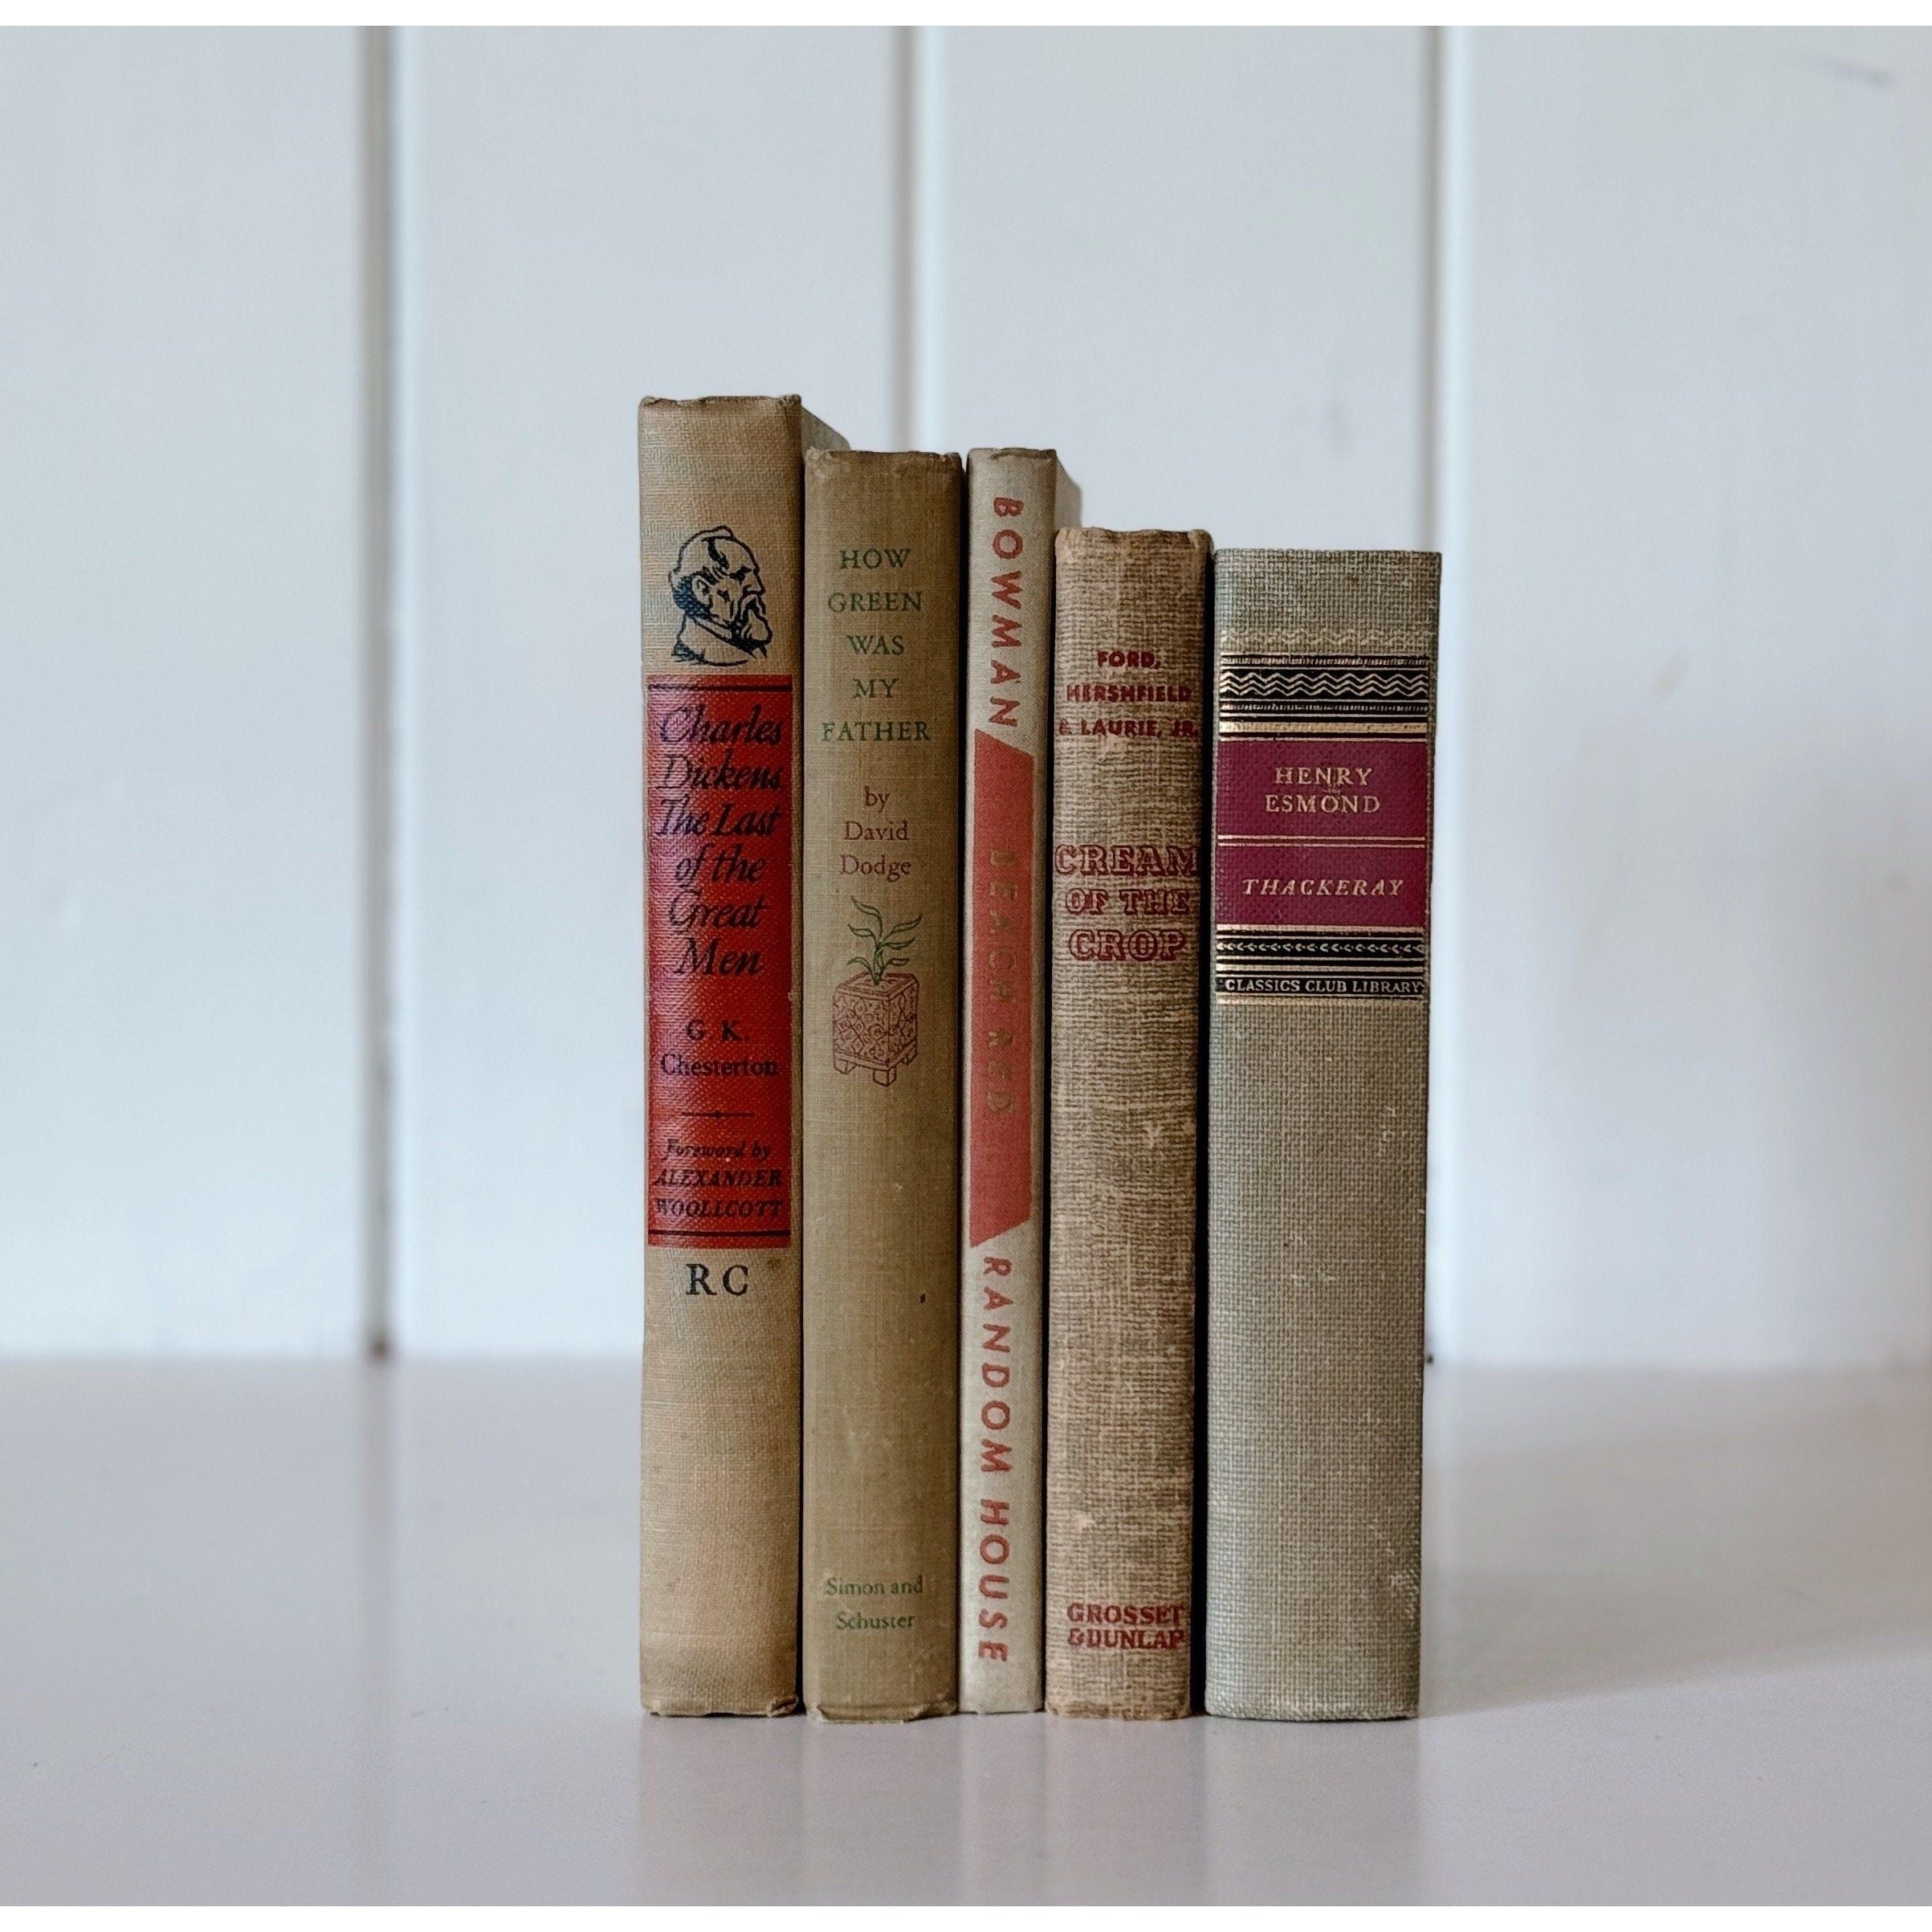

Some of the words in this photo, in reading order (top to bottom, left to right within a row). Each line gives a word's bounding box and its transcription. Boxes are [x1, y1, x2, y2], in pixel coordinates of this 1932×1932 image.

[840, 548, 911, 569] HOW
[828, 591, 922, 613] GREEN
[988, 496, 1024, 727] BOWMAN
[847, 635, 905, 655] WAS
[1097, 650, 1161, 670] FORD,
[852, 679, 899, 698] MY
[1066, 684, 1192, 703] HERSHFIELD
[658, 703, 783, 745] Charles
[821, 722, 930, 741] FATHER
[1058, 720, 1072, 736] &
[1081, 719, 1162, 737] LAURIE,
[1172, 719, 1199, 737] JR.
[656, 748, 783, 789] Dickens
[1275, 767, 1373, 786] HENRY
[864, 786, 889, 812] by
[1265, 794, 1380, 813] ESMOND
[655, 794, 709, 836] The
[712, 801, 782, 838] Last
[844, 821, 909, 842] David
[675, 843, 713, 891] of
[711, 843, 766, 884] the
[840, 855, 911, 882] Dodge
[1054, 844, 1198, 878] CREAM
[1242, 879, 1404, 896] THACKERAY
[668, 889, 774, 931] Great
[1066, 888, 1109, 916] OF
[1119, 888, 1191, 916] THE
[988, 849, 1017, 1004] BEACH
[673, 936, 764, 976] Men
[1069, 929, 1187, 962] CROP
[1225, 980, 1300, 992] CLASSICS
[1305, 980, 1347, 992] CLUB
[1353, 981, 1421, 994] LIBRARY
[687, 1020, 713, 1041] G.
[722, 1020, 750, 1041] K.
[660, 1053, 780, 1077] Chesterton
[663, 1138, 745, 1161] Foreword
[752, 1138, 772, 1159] by
[654, 1169, 783, 1188] ALEXANDER
[654, 1198, 783, 1218] WOOLLCOTT
[980, 1256, 1013, 1473] RANDOM
[825, 1577, 886, 1596] Simon
[891, 1574, 923, 1595] and
[978, 1498, 1010, 1662] HOUSE
[836, 1612, 915, 1630] Schuster
[1067, 1603, 1184, 1626] GROSSET
